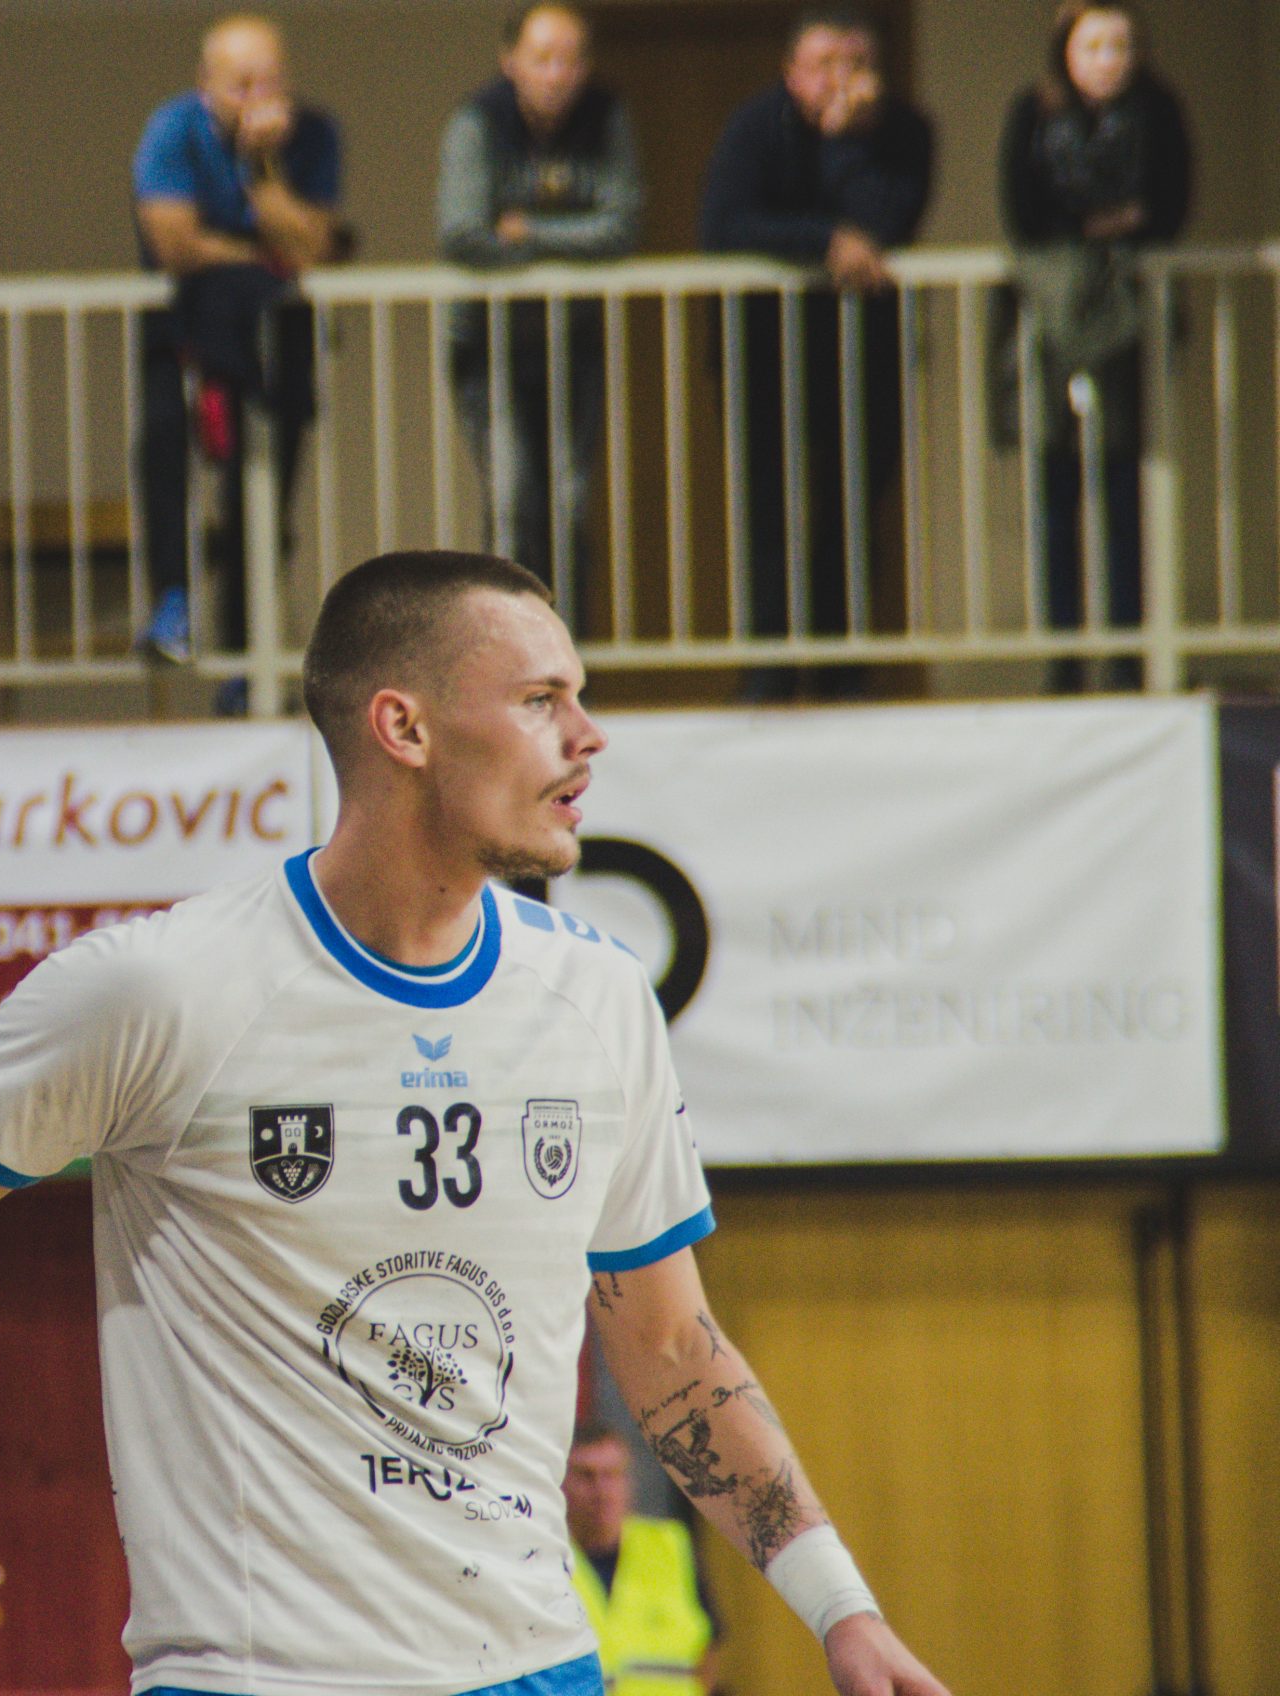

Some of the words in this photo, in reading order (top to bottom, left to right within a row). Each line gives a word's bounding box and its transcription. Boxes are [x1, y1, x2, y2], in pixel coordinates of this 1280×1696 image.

[401, 1067, 468, 1088] erima
[396, 1102, 482, 1211] 33
[375, 1250, 445, 1278] STORITVE
[445, 1254, 488, 1287] FAGUS
[484, 1280, 506, 1308] GIS
[368, 1322, 478, 1349] FAGUS
